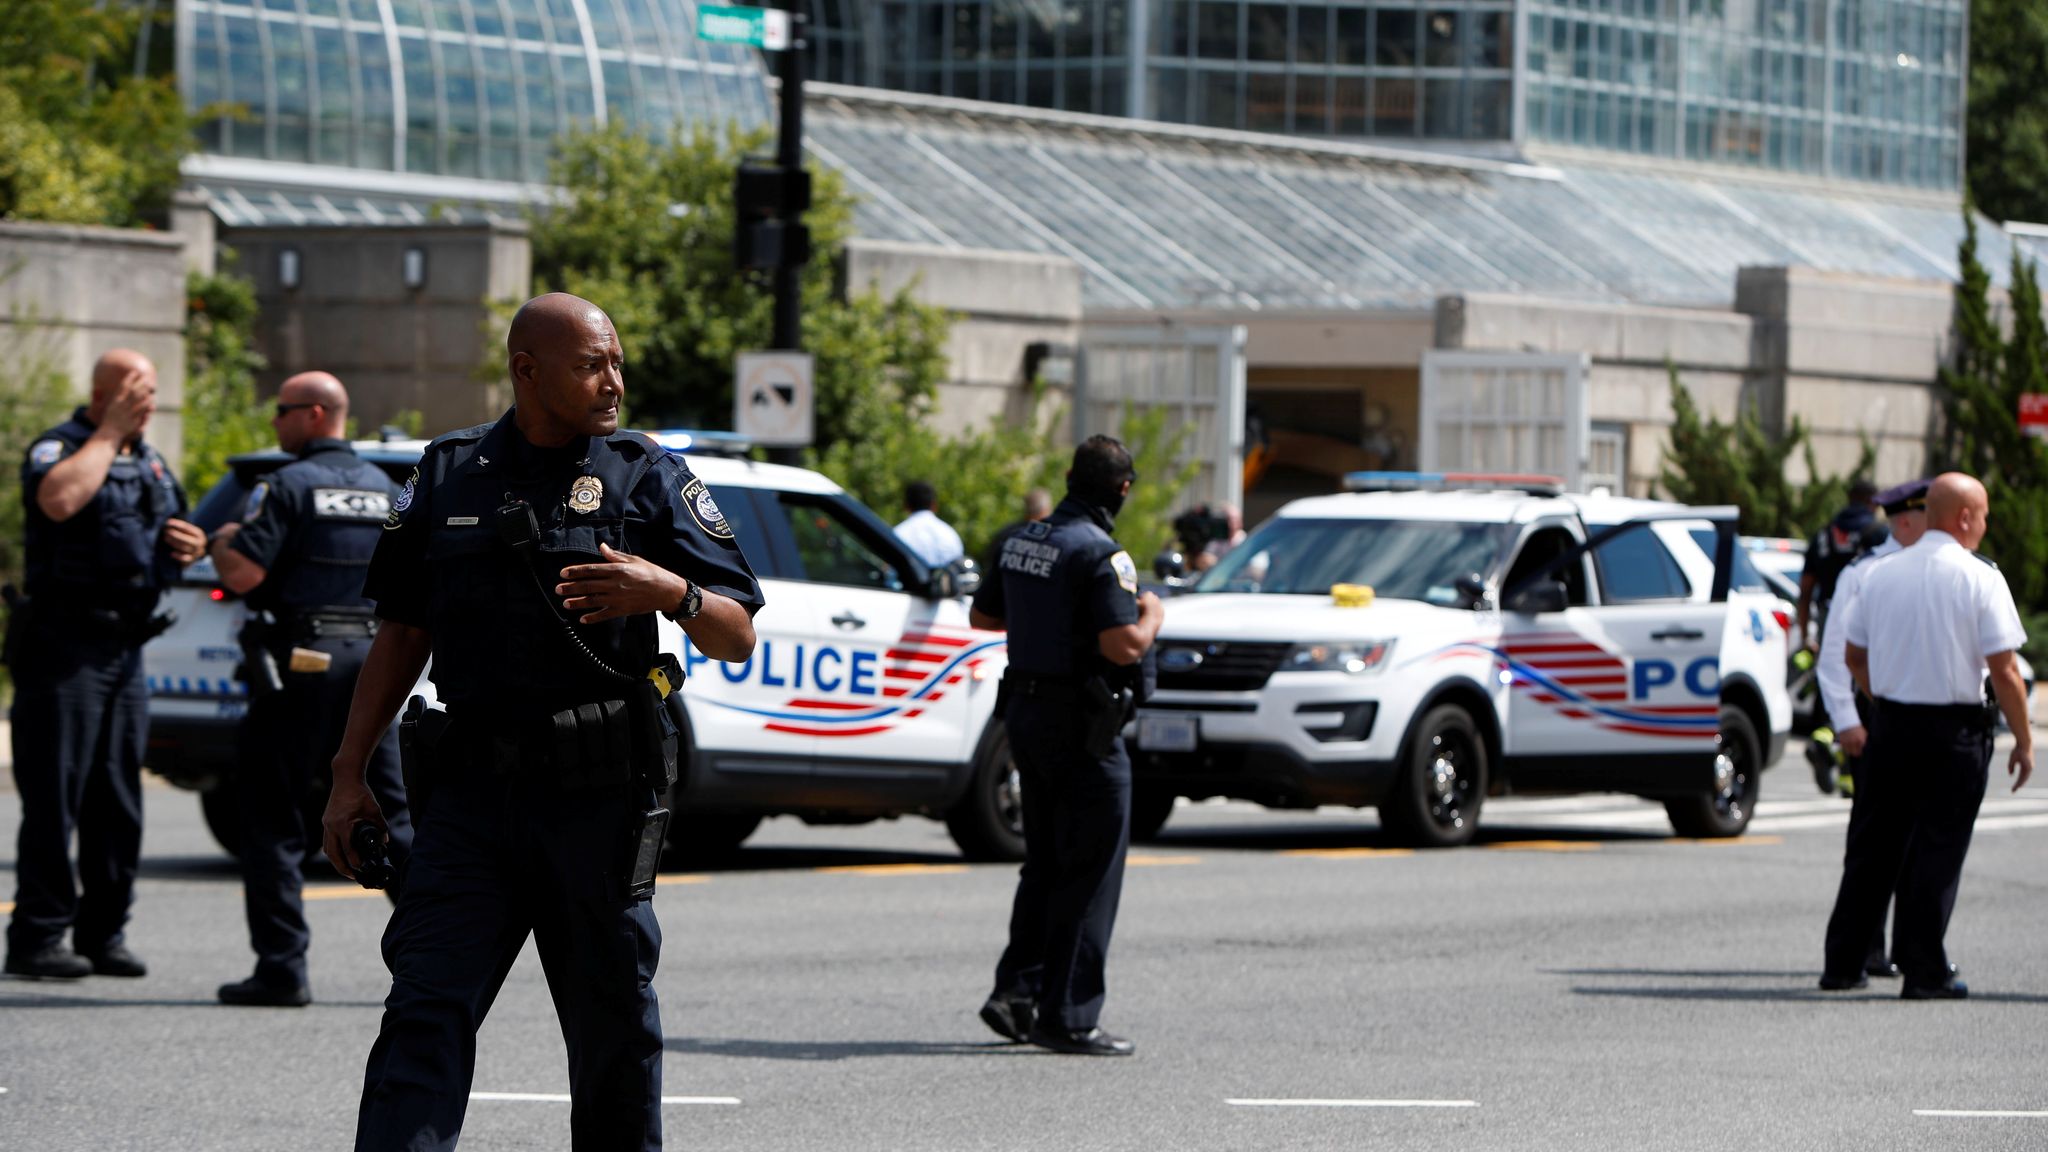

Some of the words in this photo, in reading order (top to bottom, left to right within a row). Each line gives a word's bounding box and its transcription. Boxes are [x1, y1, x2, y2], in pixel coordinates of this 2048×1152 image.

[999, 551, 1053, 579] POLICE
[683, 634, 877, 696] POLICE
[1633, 655, 1720, 699] PO
